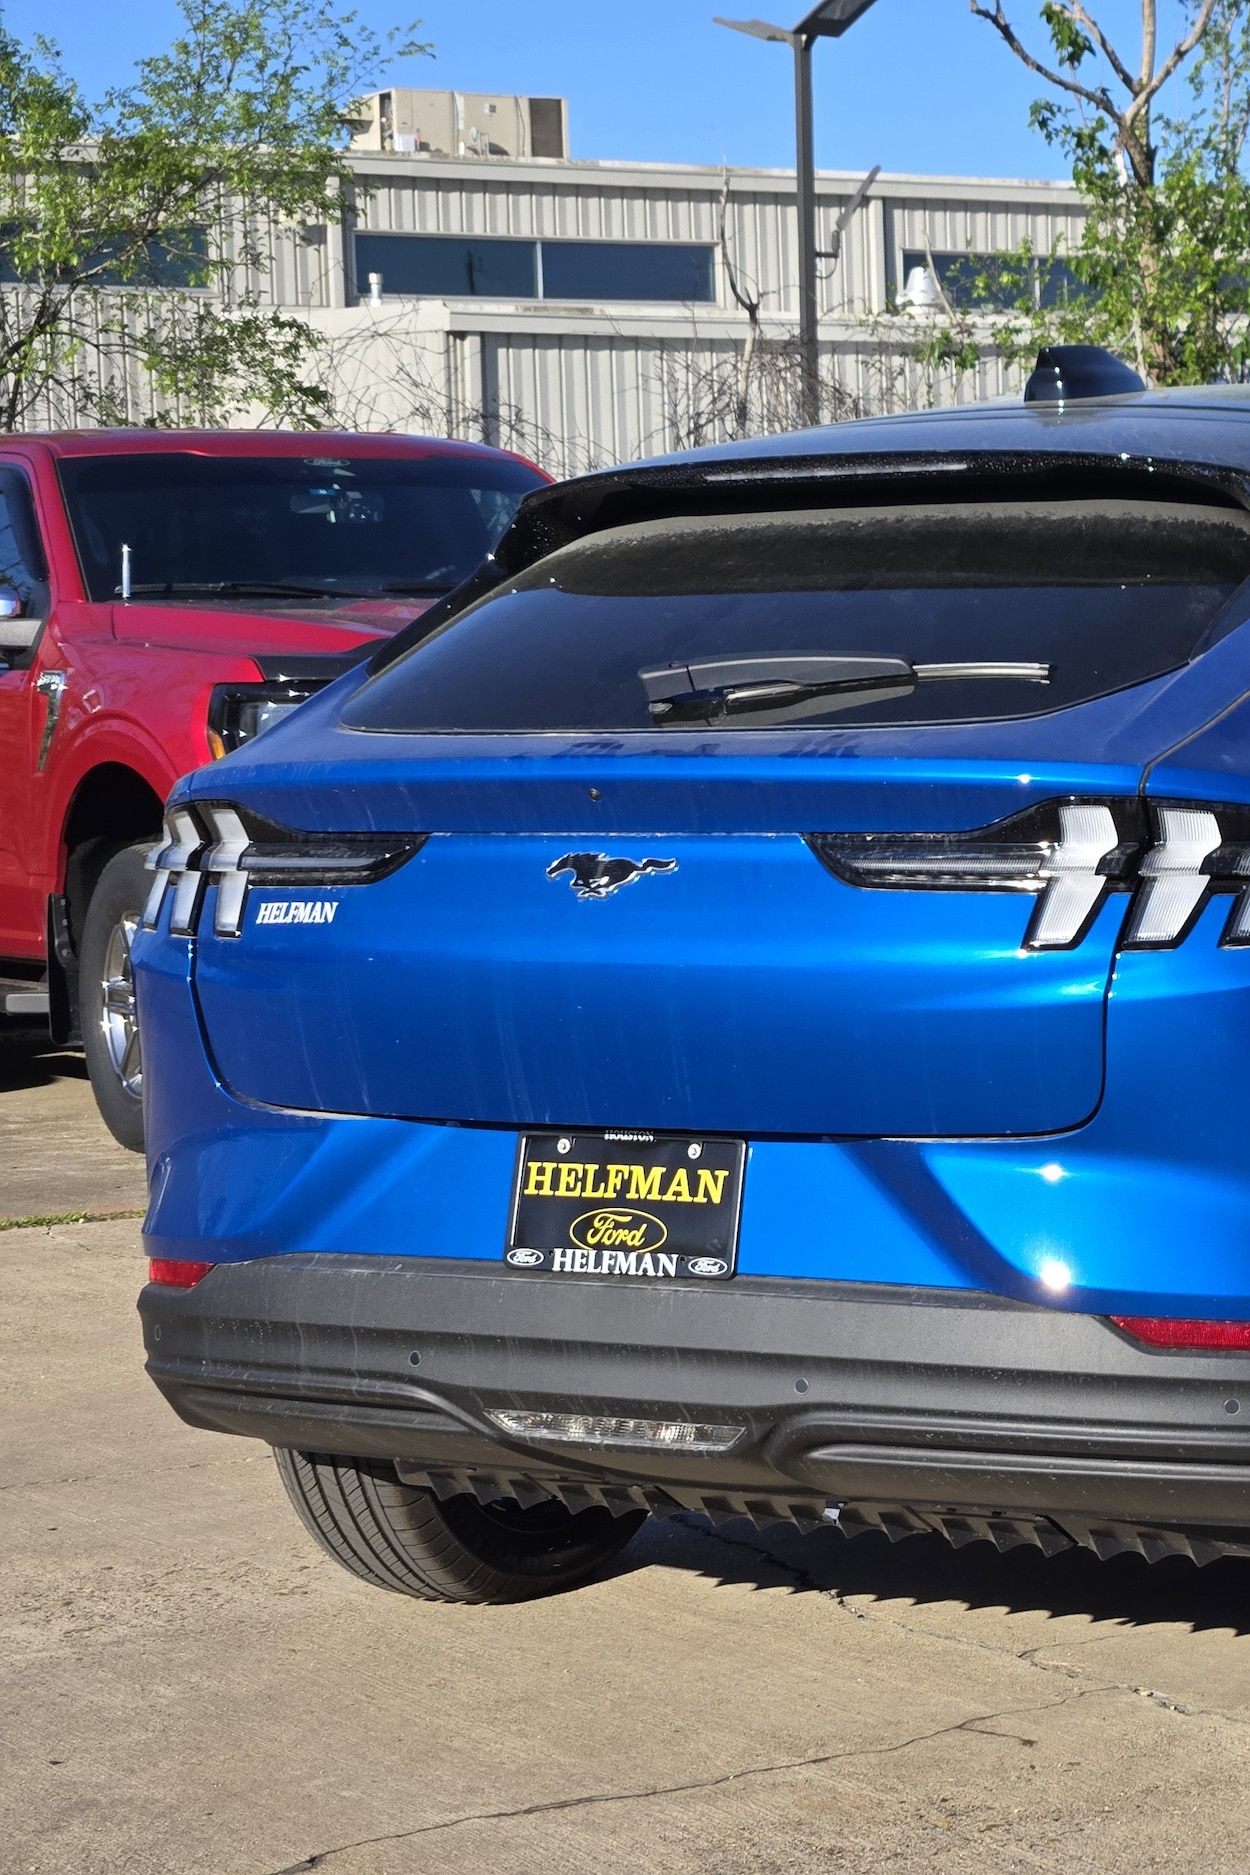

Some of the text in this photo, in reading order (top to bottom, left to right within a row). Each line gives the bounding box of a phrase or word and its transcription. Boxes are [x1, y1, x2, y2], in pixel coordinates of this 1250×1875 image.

[256, 901, 339, 924] HELFMAN
[523, 1161, 729, 1204] HELFMAN
[586, 1213, 647, 1247] Ford
[512, 1250, 538, 1263] Ford
[551, 1248, 679, 1277] HELFMAN
[694, 1260, 721, 1273] Ford
